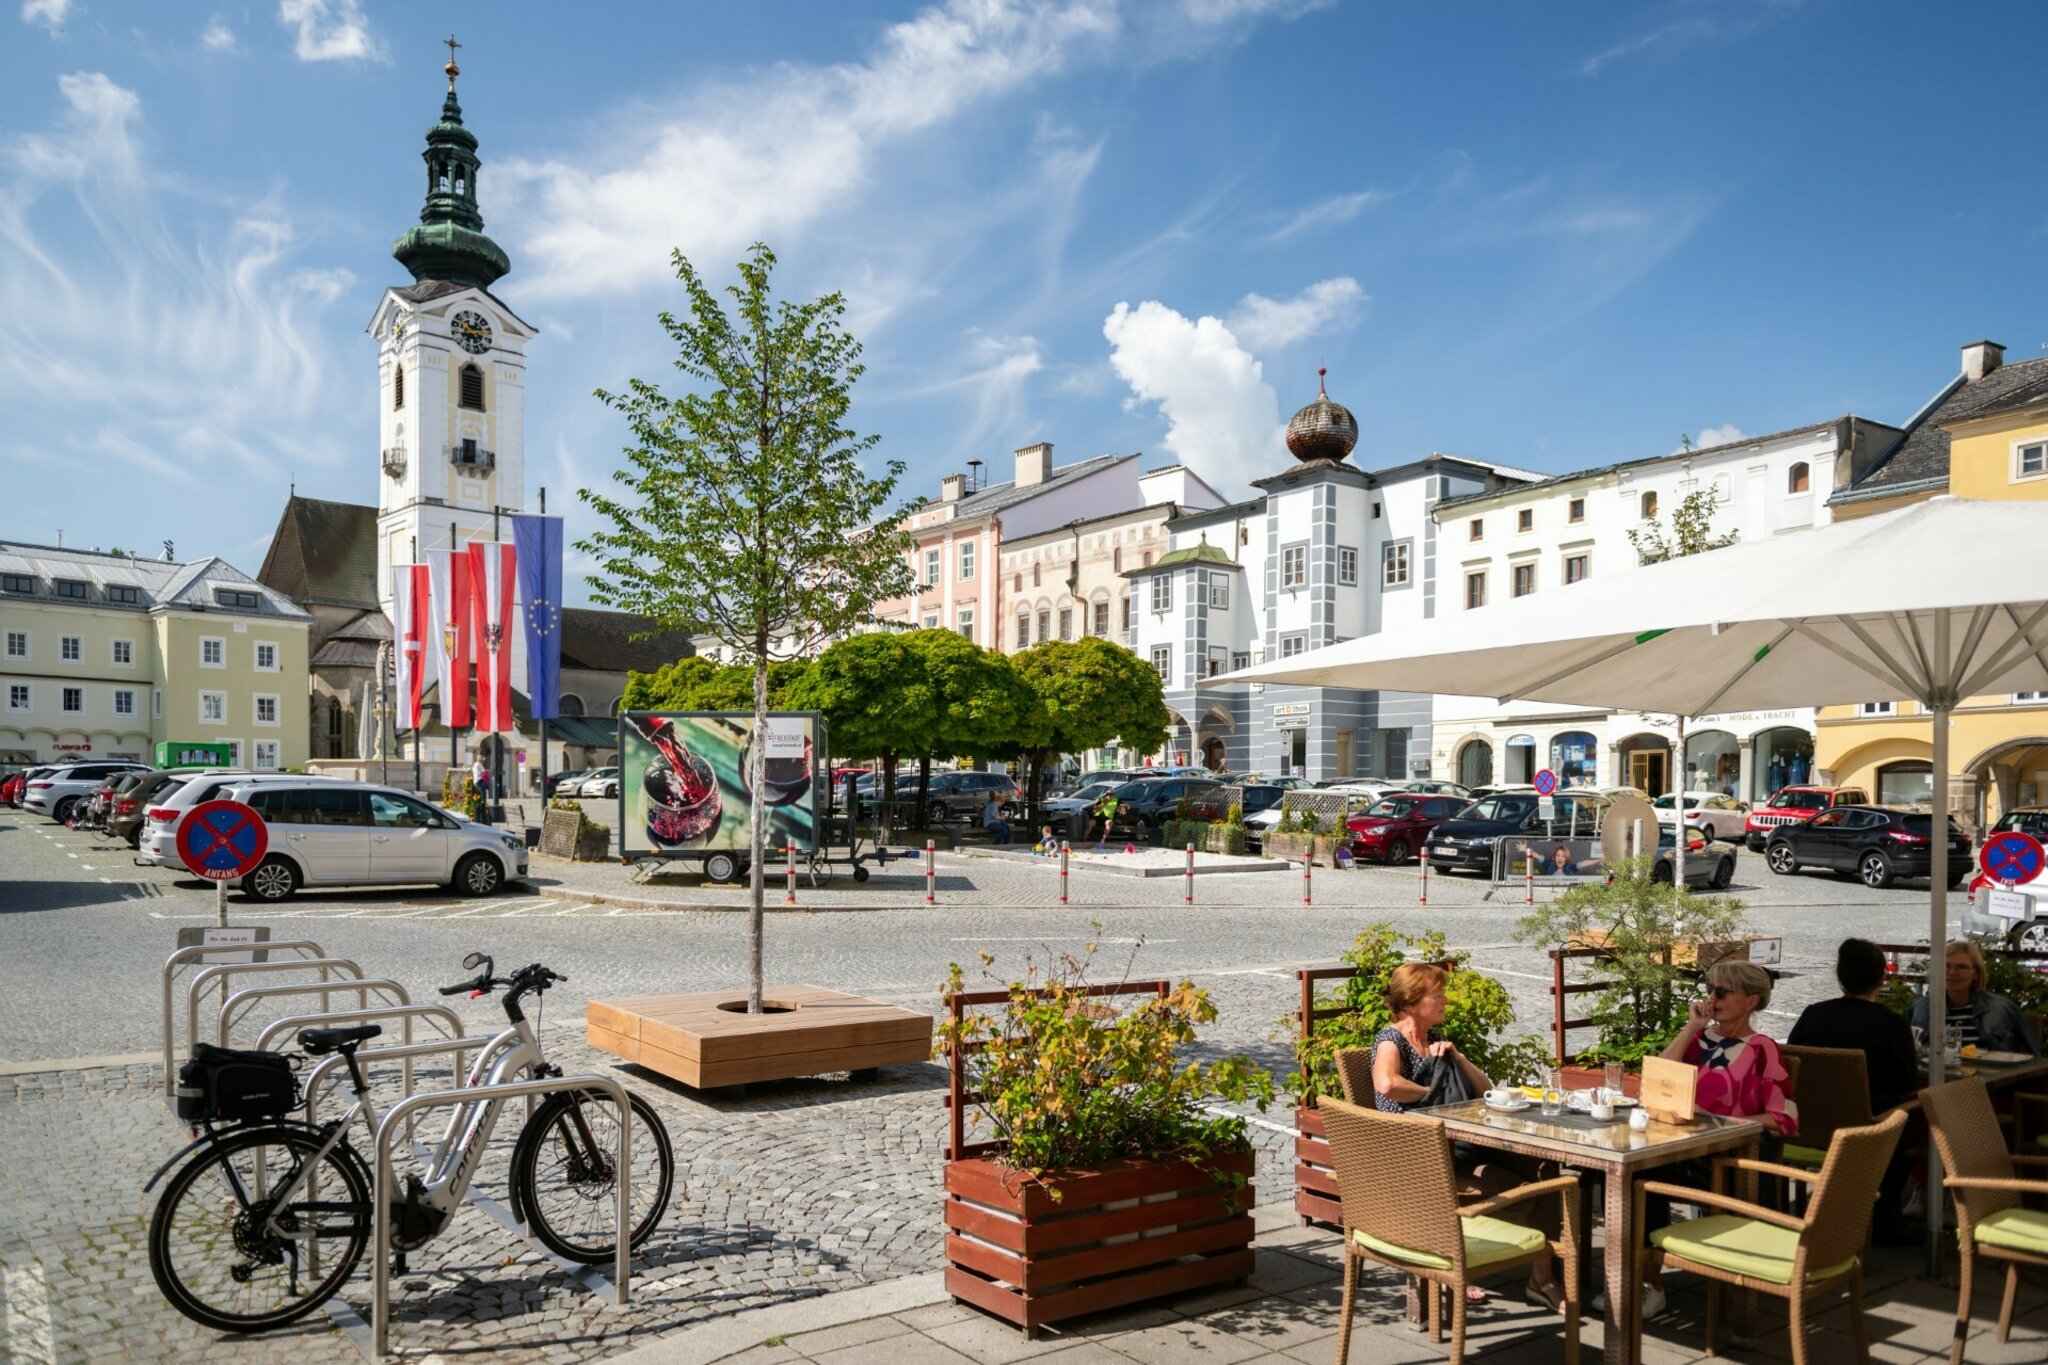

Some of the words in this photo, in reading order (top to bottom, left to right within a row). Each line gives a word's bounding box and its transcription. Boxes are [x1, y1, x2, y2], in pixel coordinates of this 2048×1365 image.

[1729, 713, 1753, 721] MODE
[1763, 711, 1796, 720] TRACHT
[204, 868, 239, 879] ANFANG
[449, 1098, 495, 1197] corrate
